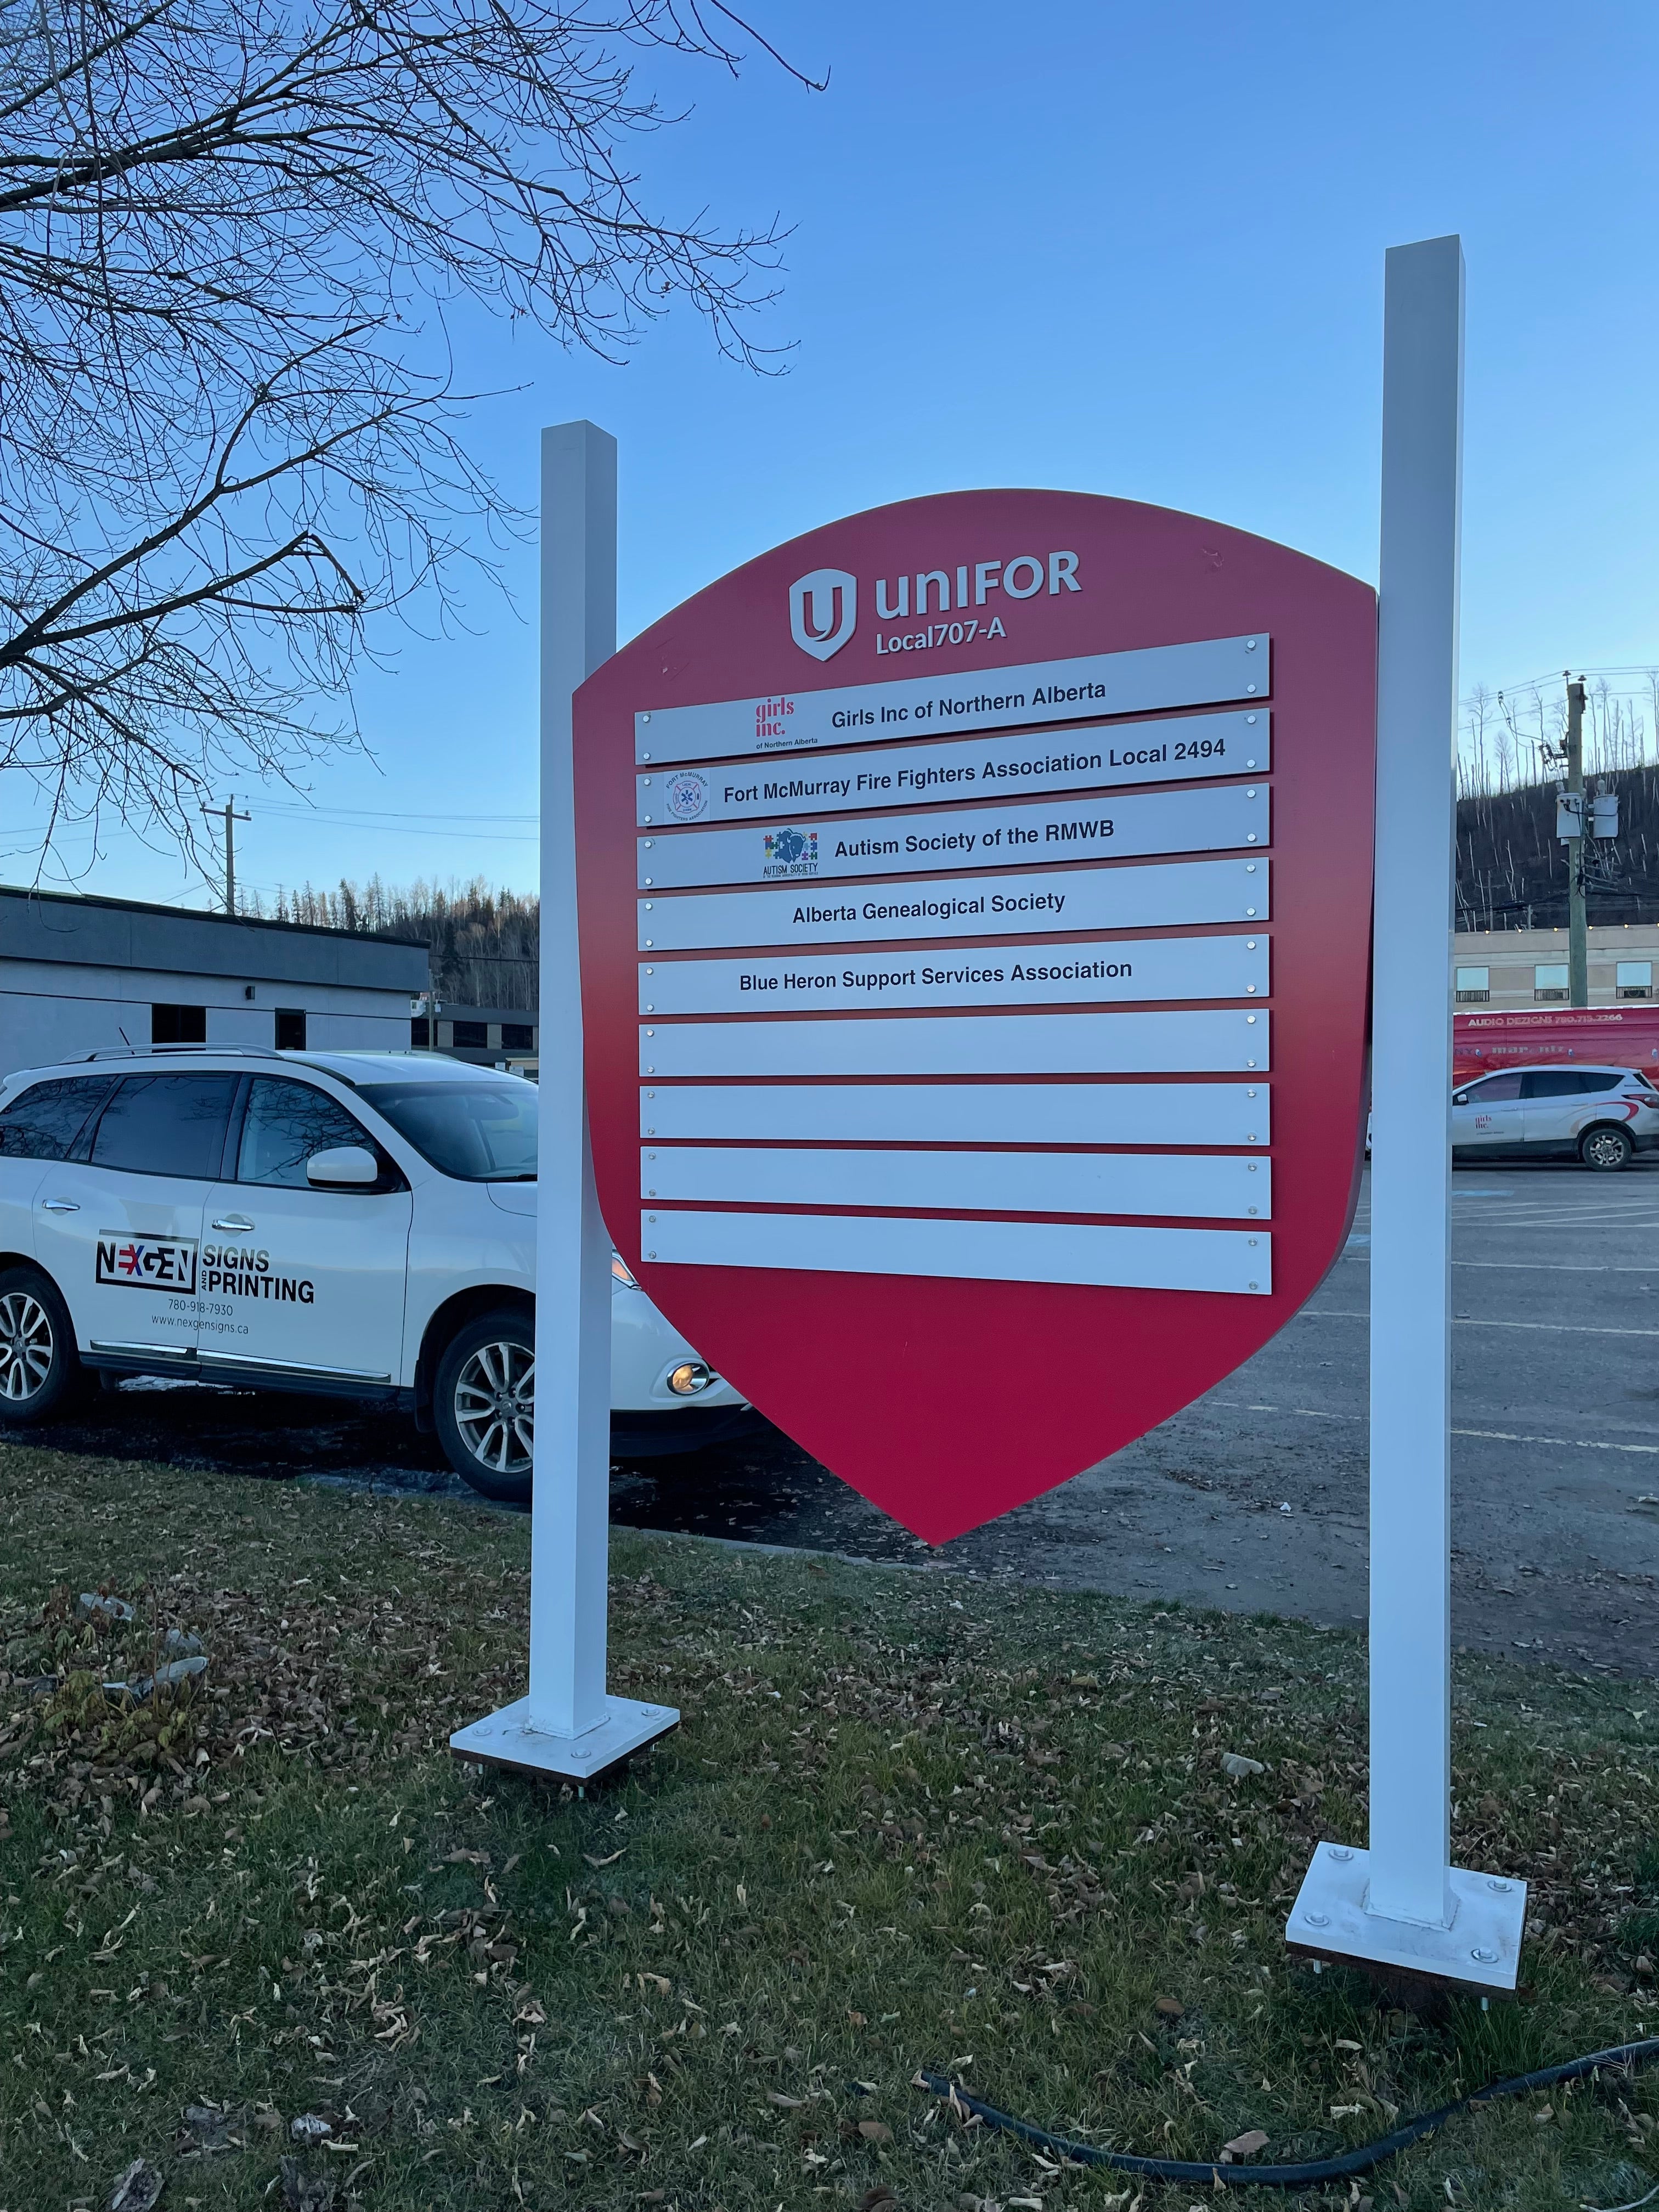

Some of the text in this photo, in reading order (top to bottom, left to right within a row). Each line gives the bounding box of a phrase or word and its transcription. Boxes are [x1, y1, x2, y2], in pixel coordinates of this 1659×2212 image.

[756, 697, 794, 723] girls
[832, 682, 1106, 728] Girls Inc of Northern Alberta
[756, 719, 786, 737] inc.
[794, 737, 817, 746] Alberta
[666, 774, 679, 789] FORT
[724, 738, 1226, 803] Fort McMurray Fire Fighters Association Local 2494
[835, 820, 1114, 857] Autism Society of the RMWB
[763, 865, 787, 875] AUTISM
[790, 862, 818, 873] SOCIETY
[793, 893, 1065, 923] Alberta Genealogical Society
[740, 961, 1132, 990] Blue Heron Support Services Association
[1468, 1018, 1504, 1026] AUDIO
[96, 1242, 269, 1282] NEXGEN SIGNS
[208, 1271, 314, 1304] PRINTING
[168, 1299, 233, 1317] 780-918-7930
[151, 1314, 249, 1335] www.nexgensigns.ca
